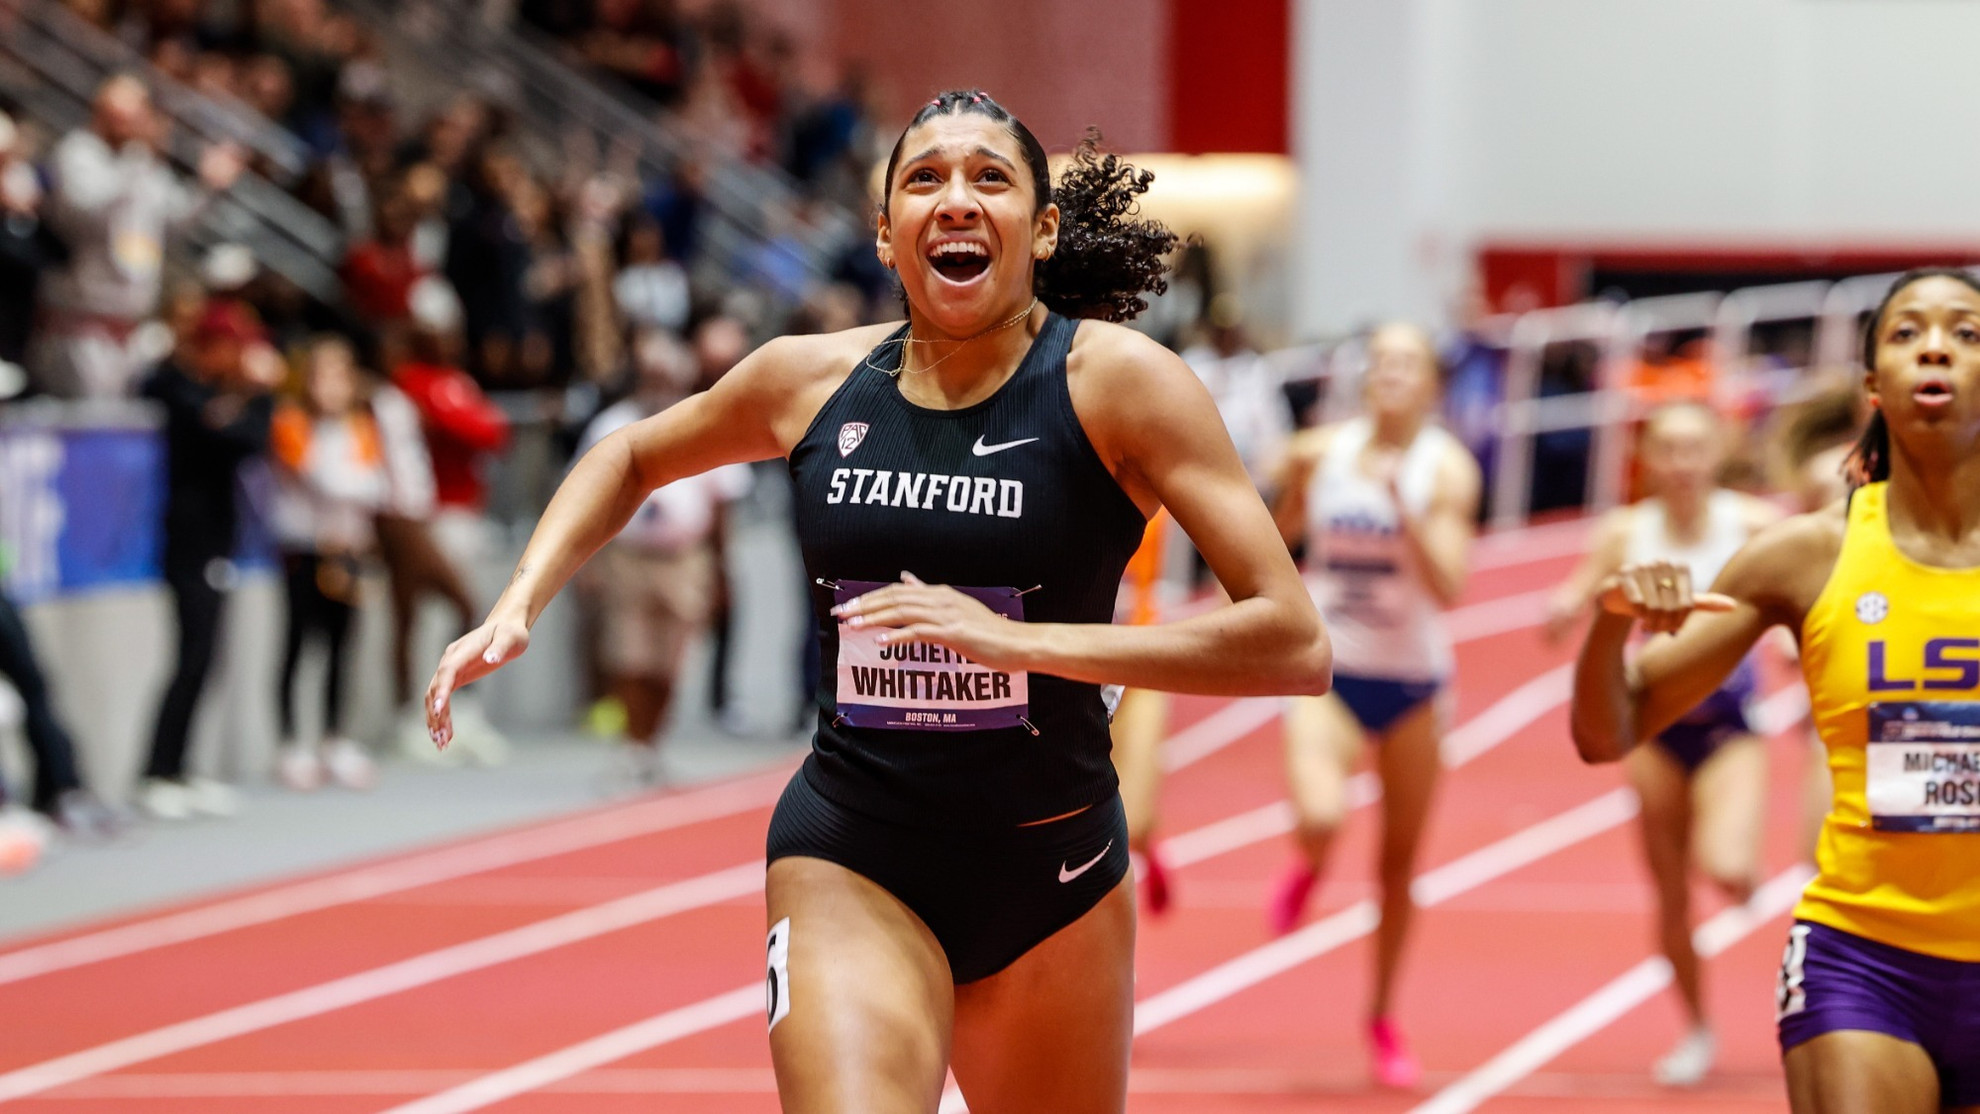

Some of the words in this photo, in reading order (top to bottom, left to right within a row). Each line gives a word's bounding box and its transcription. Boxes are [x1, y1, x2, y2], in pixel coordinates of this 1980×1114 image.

[841, 424, 867, 443] PAC
[841, 437, 857, 450] 12
[827, 468, 1024, 518] STANFORD
[880, 641, 977, 664] JULIET
[1868, 637, 1980, 691] LS
[851, 665, 1012, 701] WHITTAKER
[905, 712, 941, 724] BOSTON,
[942, 713, 957, 724] MA
[1925, 781, 1980, 806] ROS
